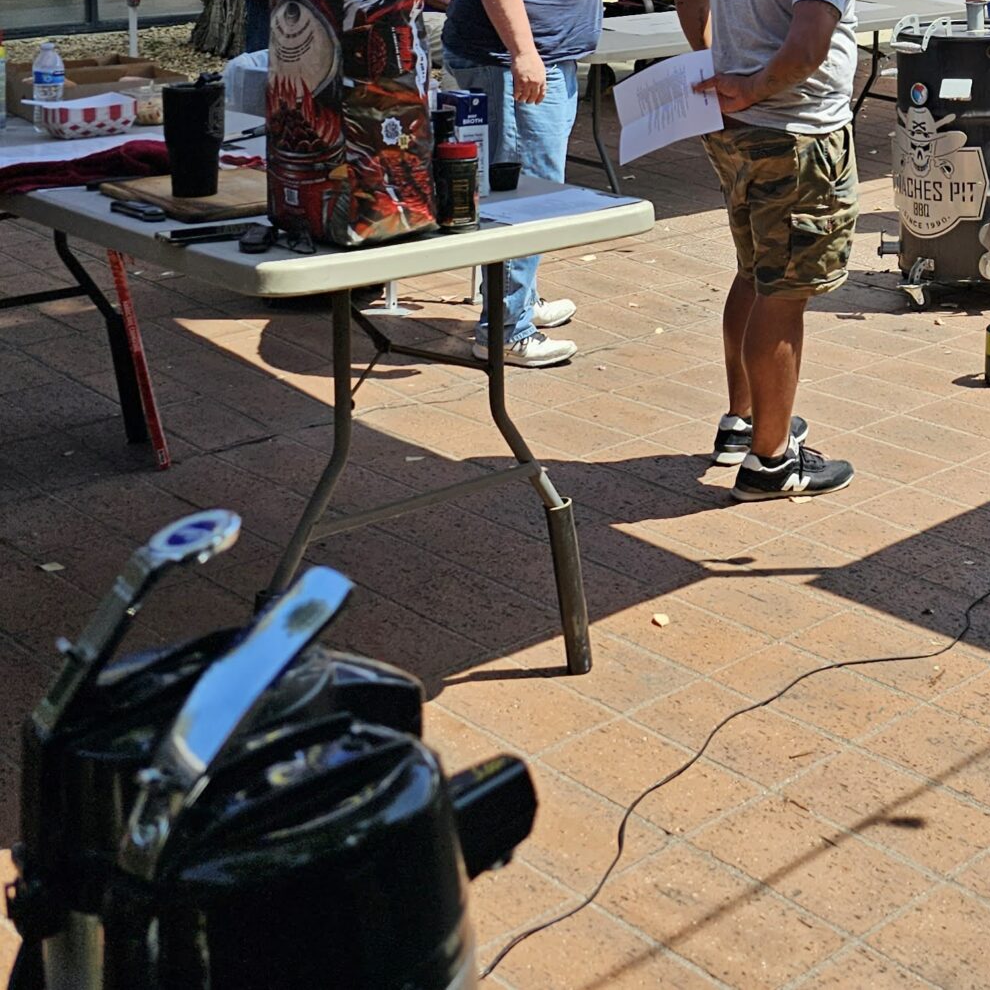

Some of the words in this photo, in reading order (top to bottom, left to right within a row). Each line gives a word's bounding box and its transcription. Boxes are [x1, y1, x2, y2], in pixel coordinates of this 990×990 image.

[949, 181, 977, 202] PIT
[903, 210, 923, 229] SINCE
[913, 202, 930, 218] BBQ
